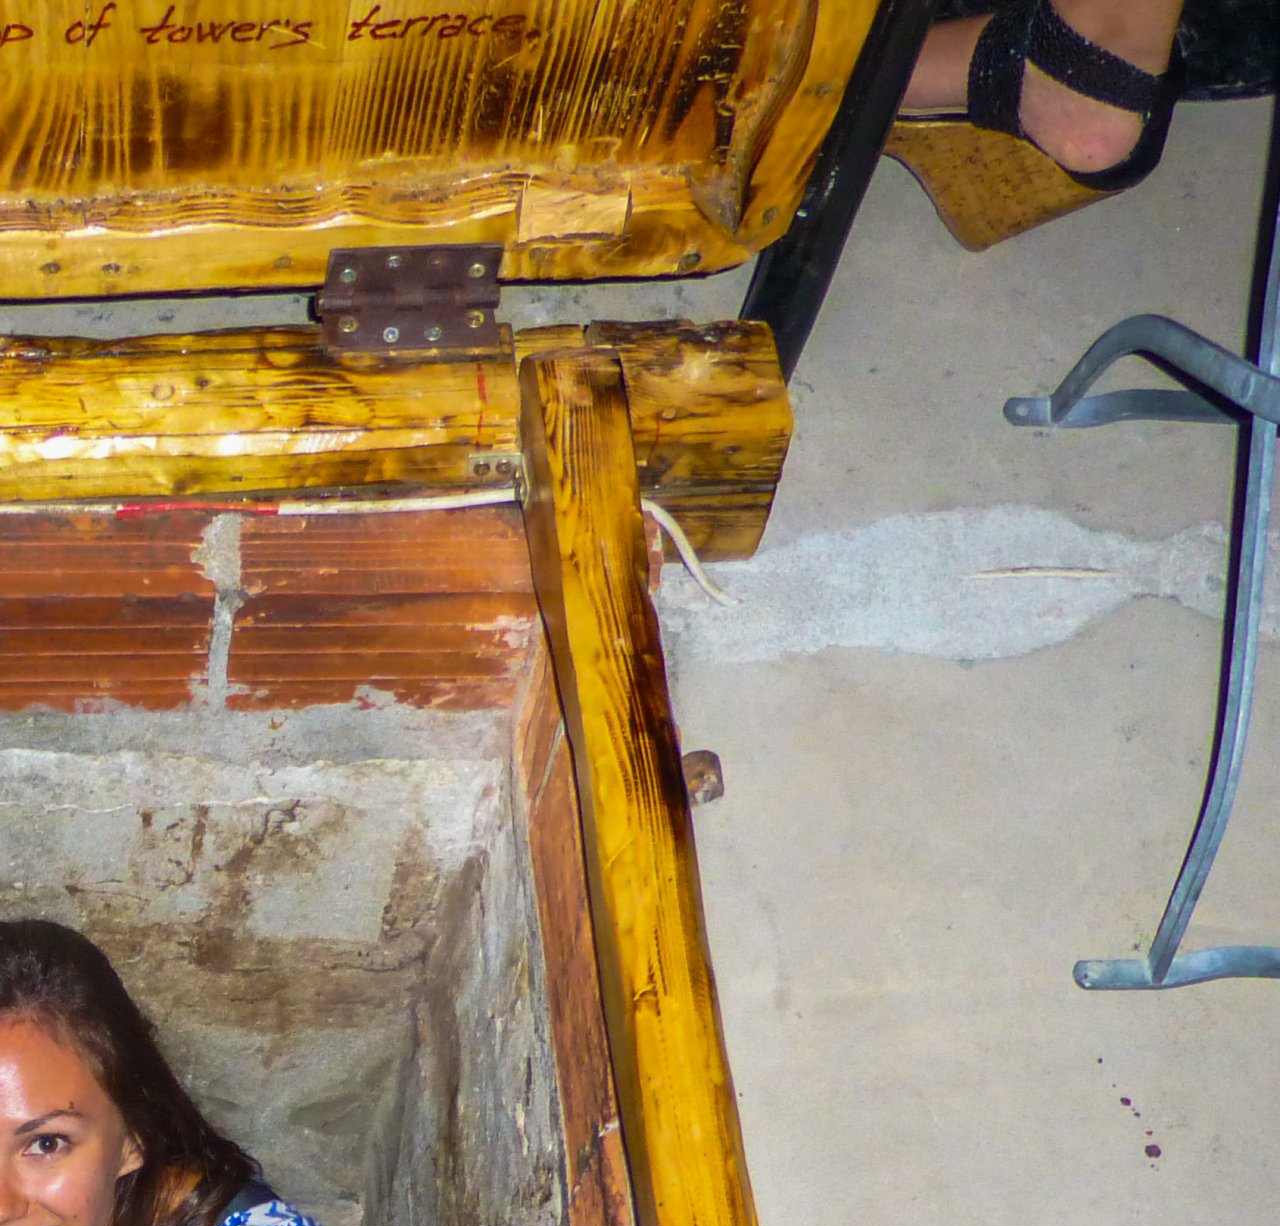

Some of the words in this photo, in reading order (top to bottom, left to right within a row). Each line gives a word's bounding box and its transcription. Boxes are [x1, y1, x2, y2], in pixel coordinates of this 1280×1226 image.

[65, 1, 117, 47] of
[140, 5, 312, 50] tower's
[347, 5, 541, 41] terrace.
